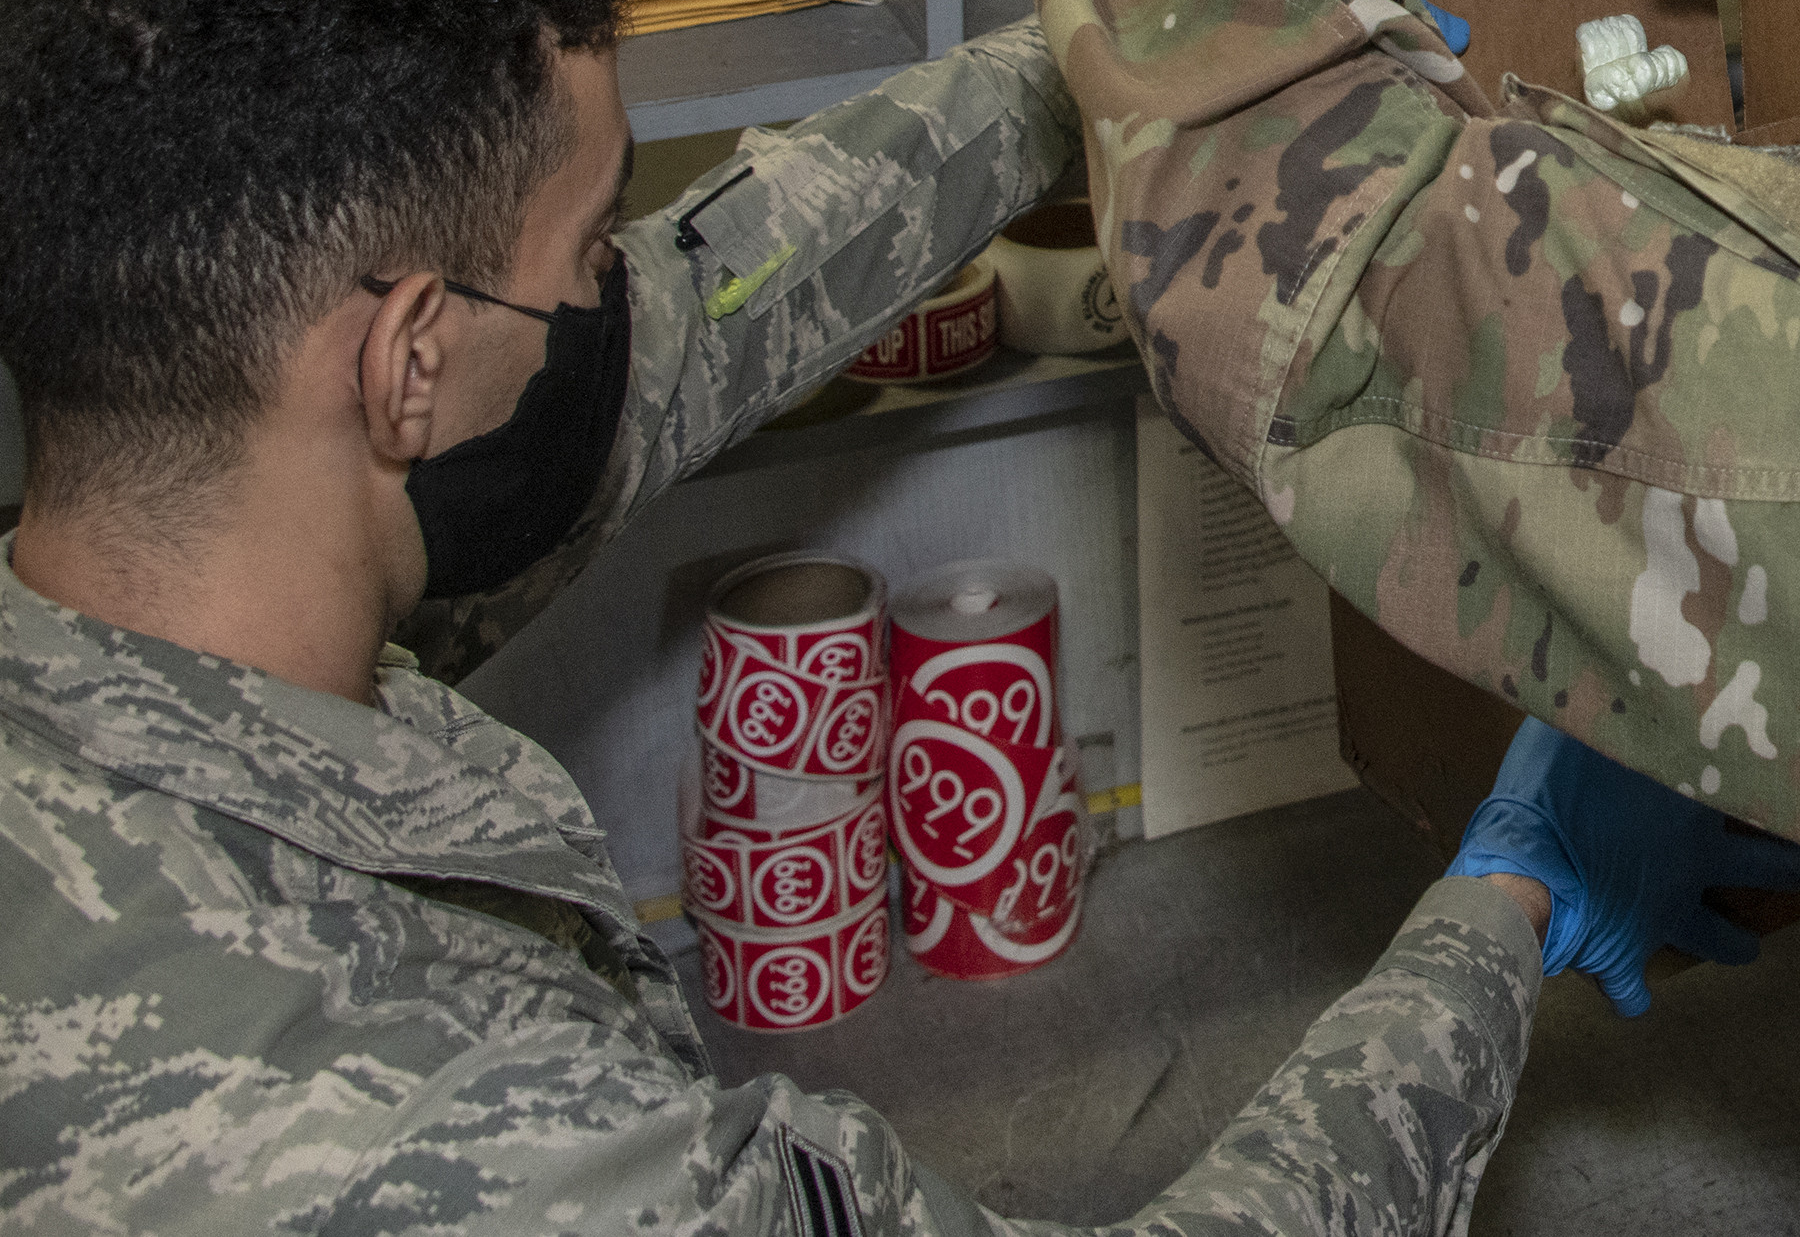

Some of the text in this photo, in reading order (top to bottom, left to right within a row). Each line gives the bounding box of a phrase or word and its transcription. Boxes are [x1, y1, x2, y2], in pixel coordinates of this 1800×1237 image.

[741, 682, 793, 744] 999
[831, 702, 871, 759] 999
[901, 744, 1002, 859] 999
[773, 860, 813, 912] 999
[768, 958, 808, 1012] 999
